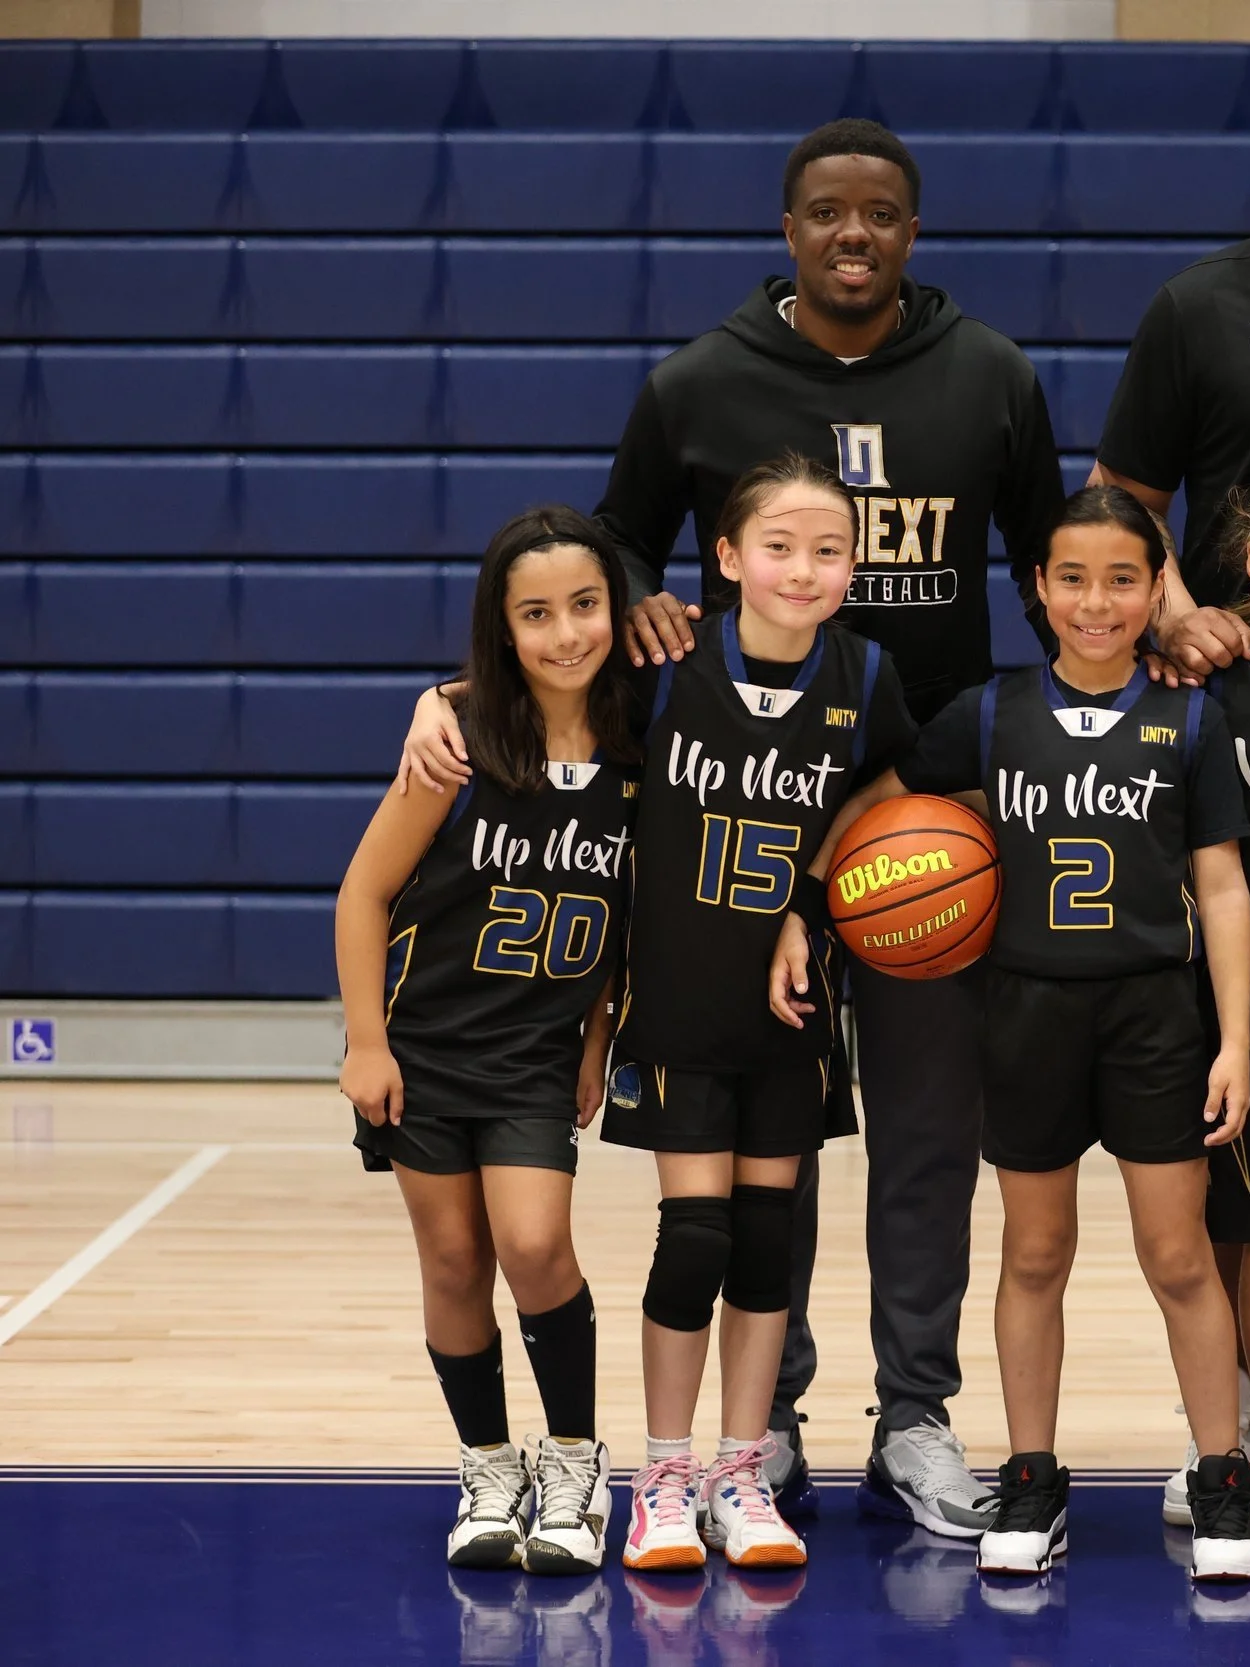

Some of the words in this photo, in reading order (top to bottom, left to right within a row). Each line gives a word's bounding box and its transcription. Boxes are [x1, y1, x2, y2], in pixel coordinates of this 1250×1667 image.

[847, 577, 943, 601] ETBALL
[826, 707, 857, 728] UNITY
[1140, 725, 1177, 746] UNITY
[668, 731, 725, 806] Up
[742, 747, 845, 809] Next
[998, 768, 1049, 833] Up
[1064, 763, 1175, 823] Next
[472, 818, 530, 882] Up
[543, 818, 632, 880] Next
[696, 813, 801, 914] 15
[837, 848, 953, 904] Wilson
[1048, 838, 1115, 930] 2
[473, 885, 609, 979] 20
[863, 898, 967, 948] EVOLUTION
